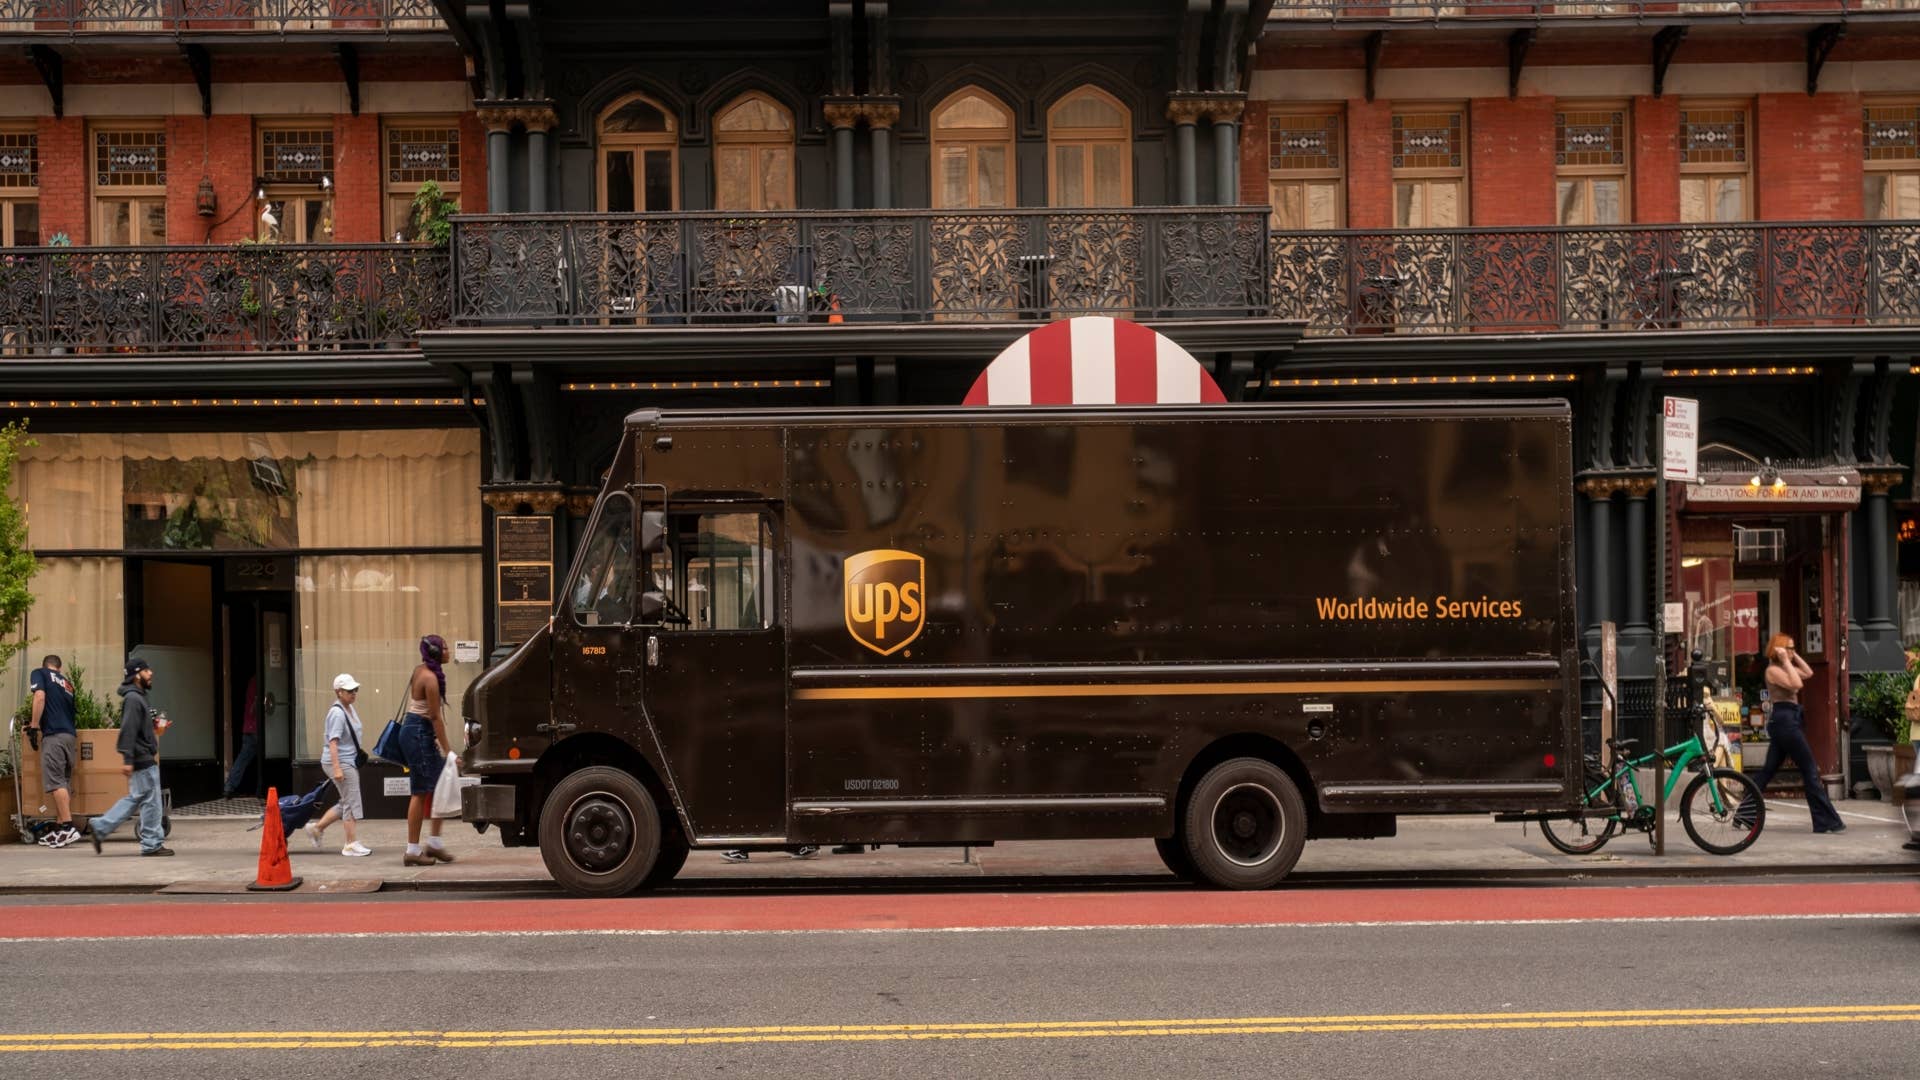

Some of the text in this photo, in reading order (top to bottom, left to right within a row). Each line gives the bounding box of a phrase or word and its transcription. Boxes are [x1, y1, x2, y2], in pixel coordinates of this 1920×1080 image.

[1667, 400, 1674, 416] 3
[1692, 487, 1856, 499] ALTERATIONS FOR MEN AND WOMEN
[238, 563, 279, 576] 220
[851, 581, 920, 639] ups
[1316, 595, 1522, 620] Worldwide Services
[582, 646, 606, 655] 167813
[844, 779, 870, 790] USDOT
